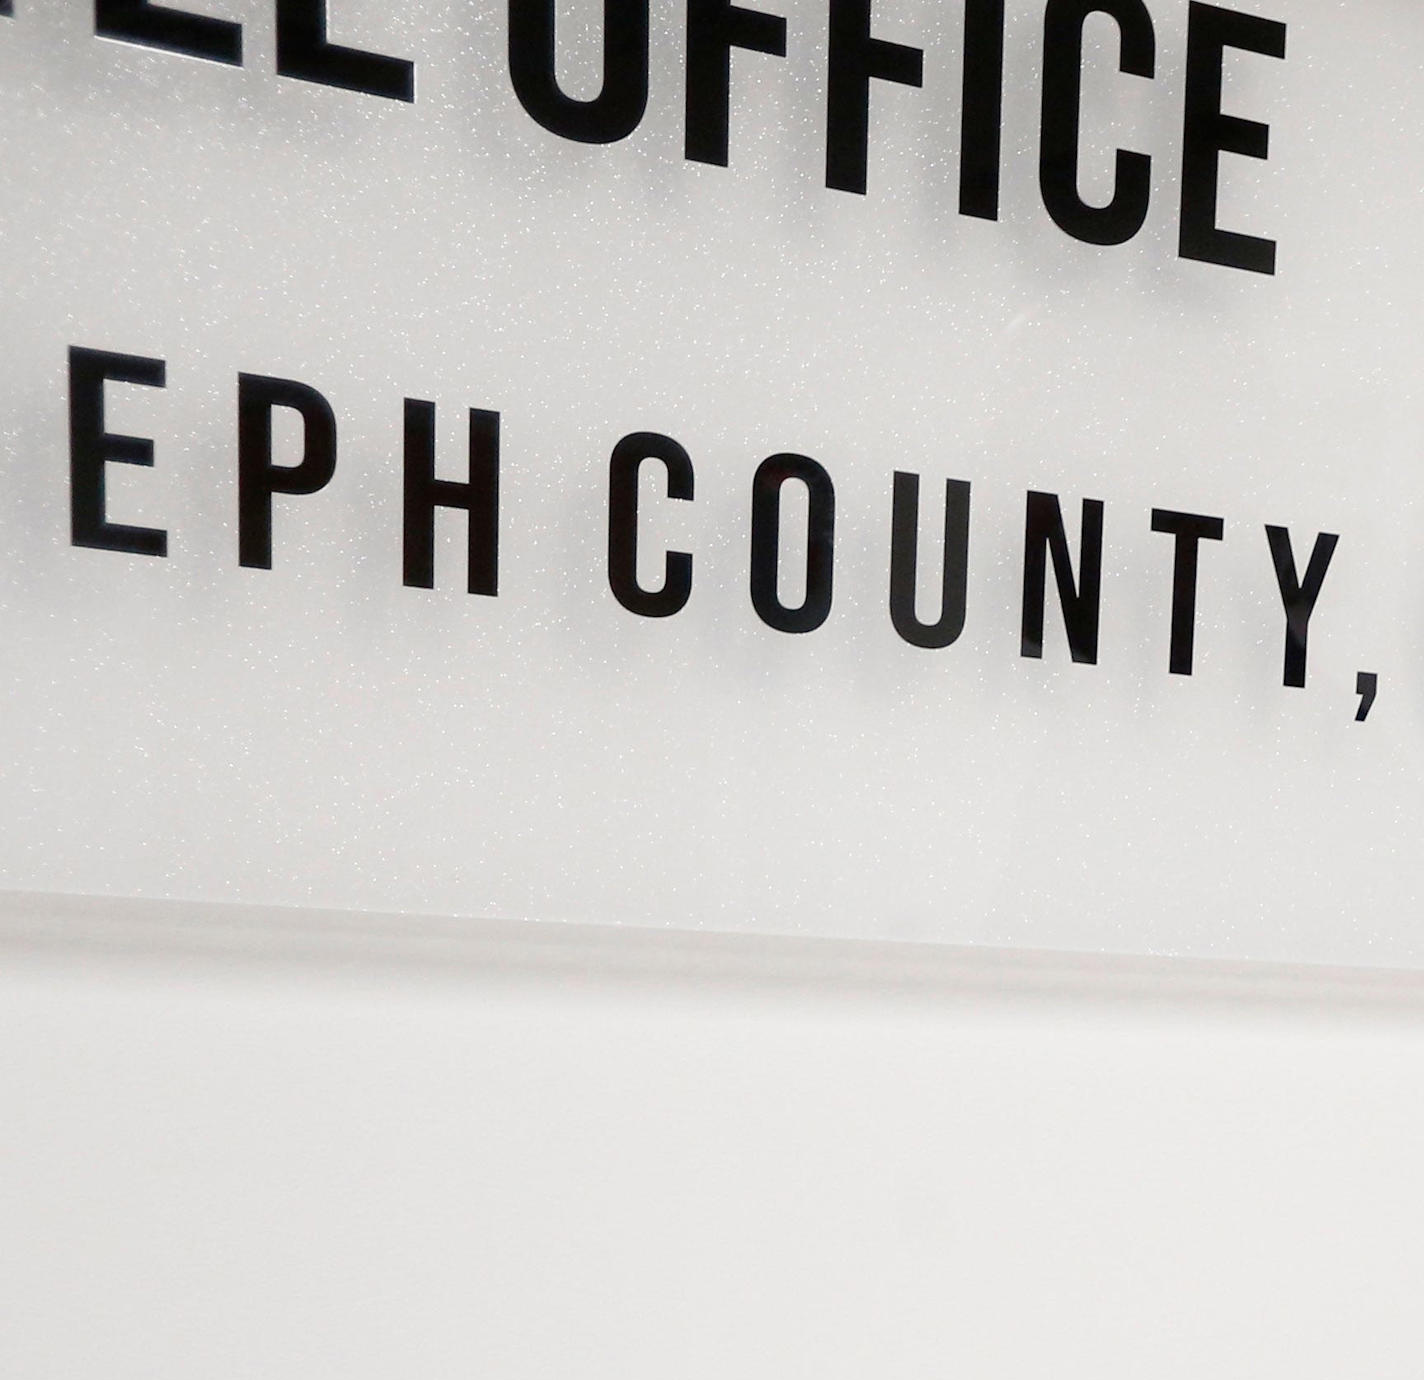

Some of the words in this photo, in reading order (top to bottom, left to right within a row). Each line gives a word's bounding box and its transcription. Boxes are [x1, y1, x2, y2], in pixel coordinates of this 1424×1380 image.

[508, 0, 1287, 275] OFFICE
[68, 345, 500, 598] EPH
[607, 431, 1379, 722] COUNTY,
